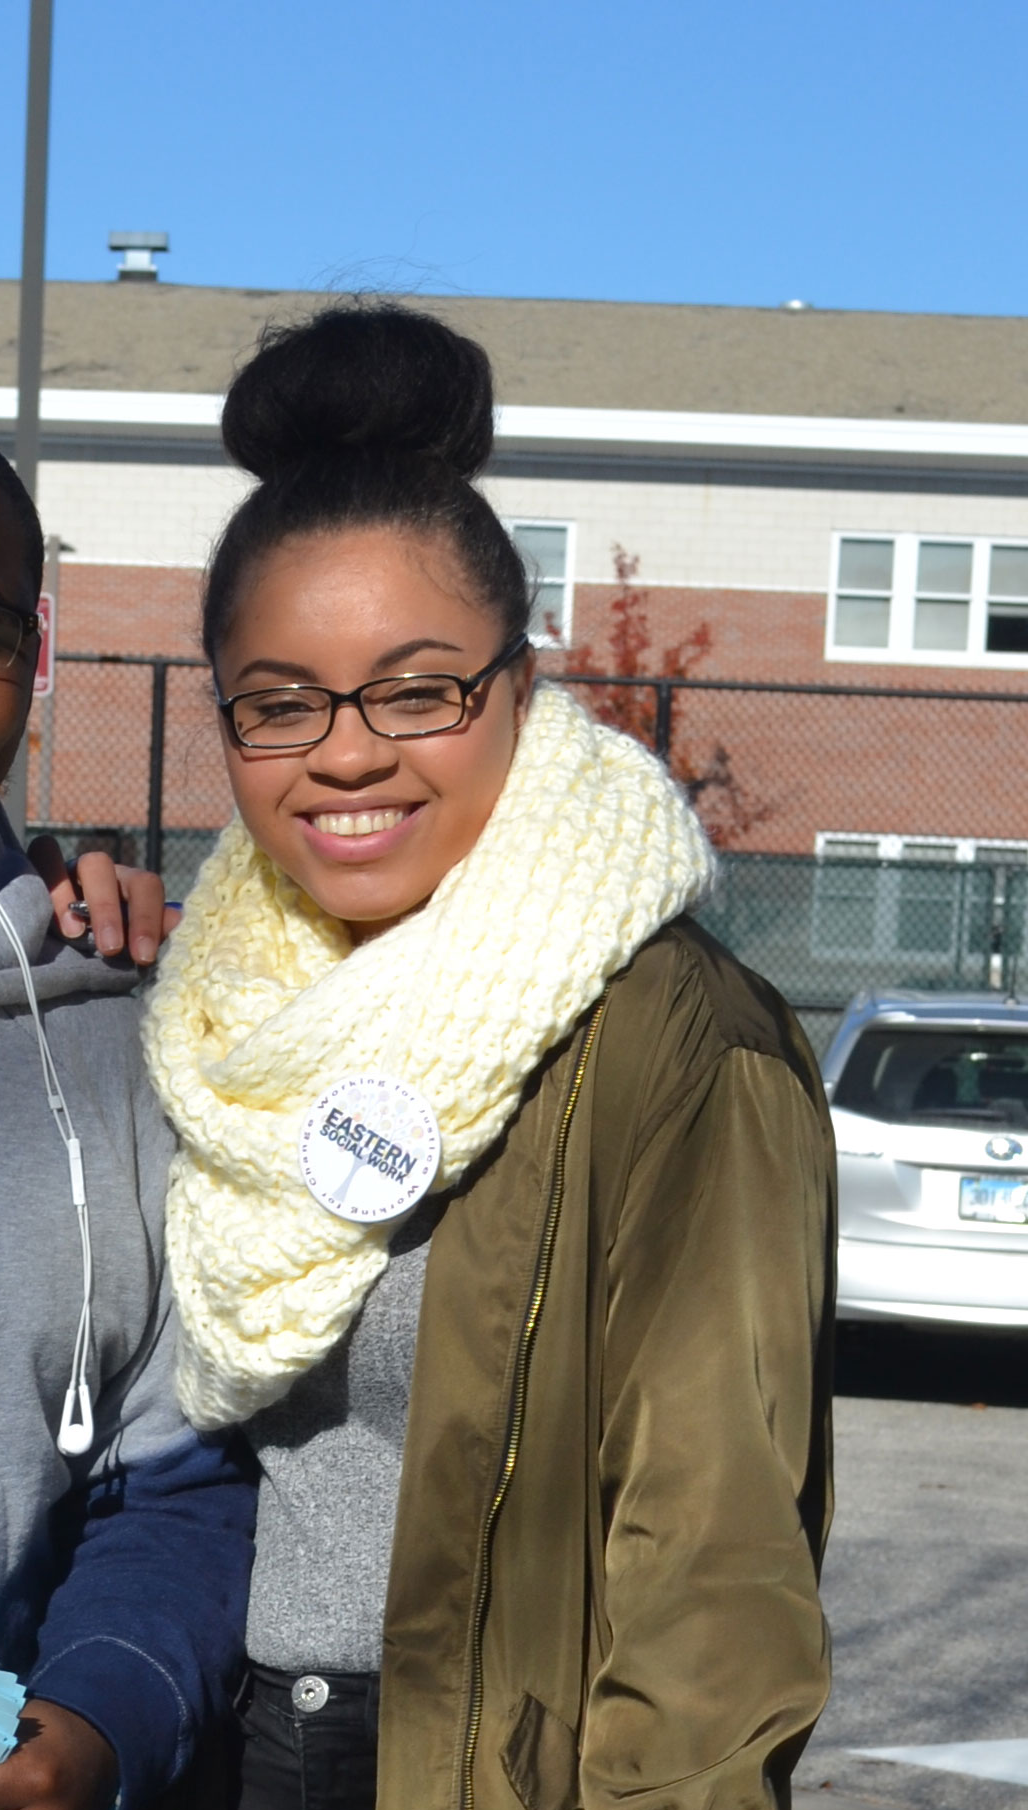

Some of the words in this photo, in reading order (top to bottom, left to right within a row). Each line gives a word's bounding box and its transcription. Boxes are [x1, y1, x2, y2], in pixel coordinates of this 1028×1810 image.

[317, 1078, 386, 1109] Working
[395, 1085, 415, 1101] for
[319, 1124, 364, 1160] SOCIAL
[366, 1151, 408, 1185] WORK
[325, 1107, 417, 1174] EASTERN
